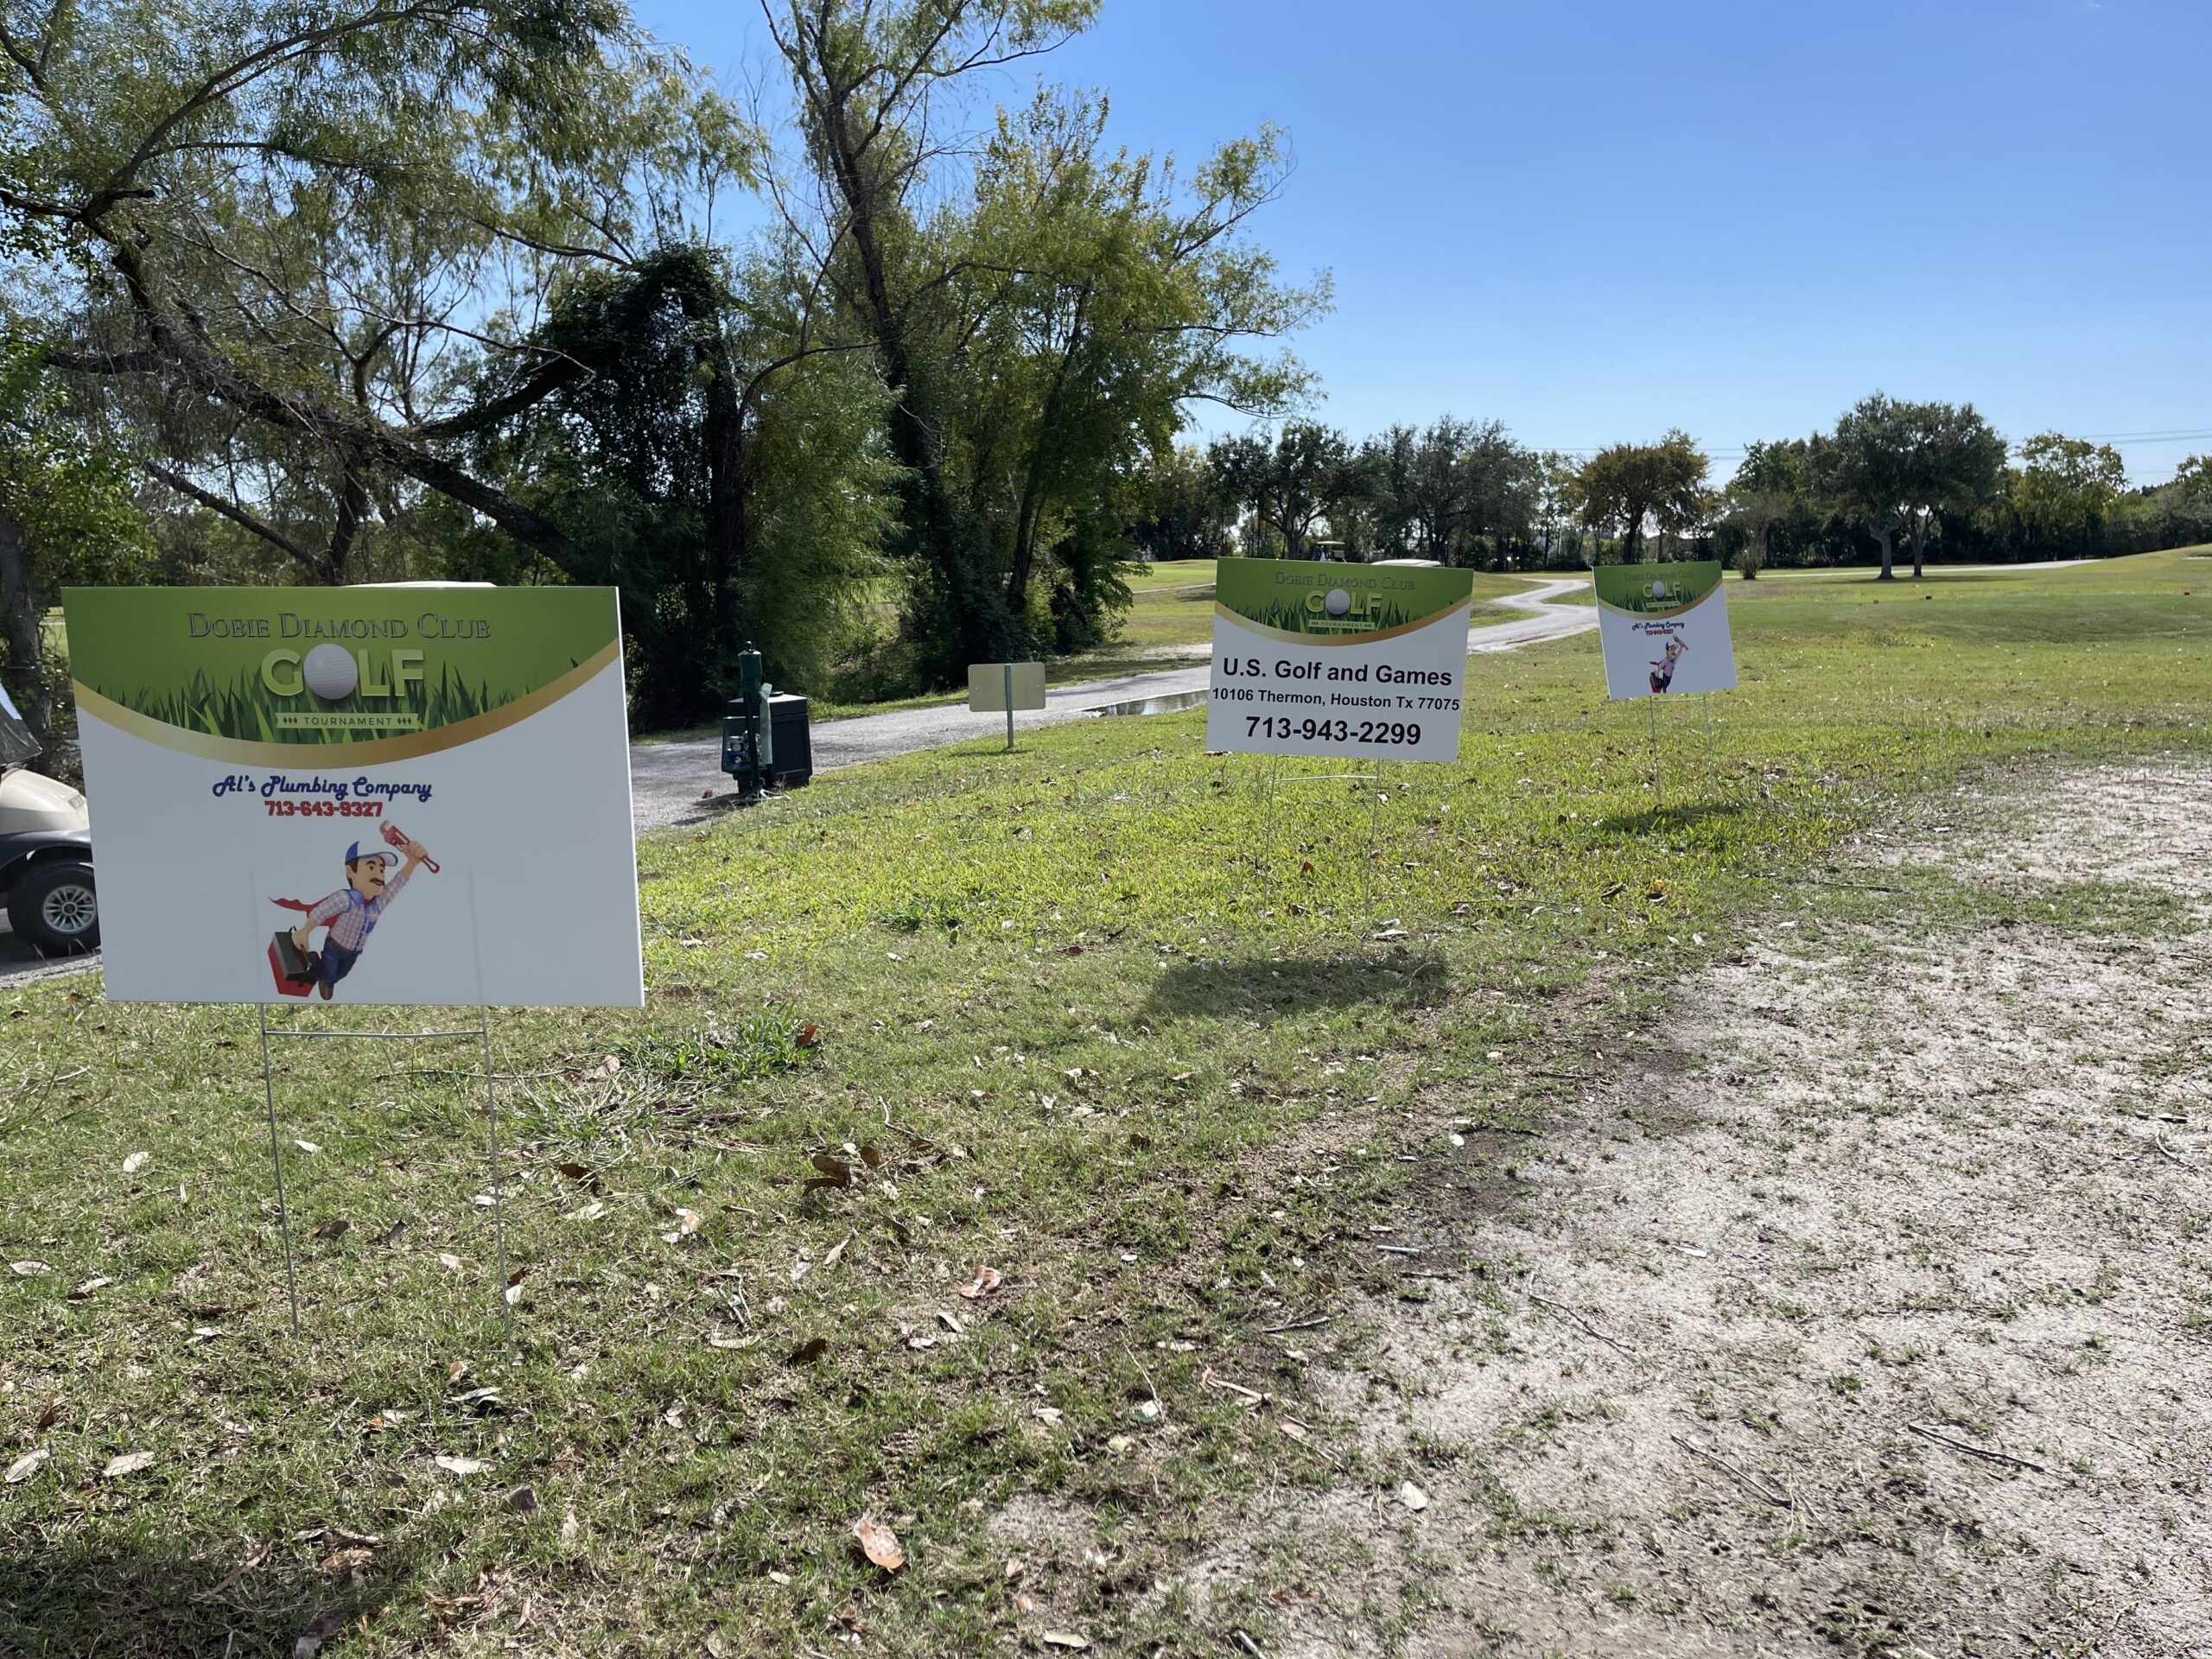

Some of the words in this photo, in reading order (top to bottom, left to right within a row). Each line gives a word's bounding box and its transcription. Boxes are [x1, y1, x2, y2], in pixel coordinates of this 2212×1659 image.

[1306, 588, 1382, 615] GOLF
[1643, 581, 1681, 599] GOLF
[188, 613, 271, 639] DOBIE
[280, 613, 409, 639] DIAMOND
[417, 613, 493, 639] CLUB
[261, 643, 425, 701] GOLF
[1224, 658, 1267, 677] U.S.
[1274, 660, 1322, 680] Golf
[1327, 664, 1368, 683] and
[1376, 664, 1452, 686] Games
[1212, 687, 1254, 702] 10106
[1258, 690, 1326, 706] Thermon,
[1331, 694, 1391, 709] Houston
[1396, 696, 1413, 709] Tx
[1418, 696, 1459, 711] 77075
[303, 715, 393, 728] TOURNAMENT
[1245, 716, 1421, 745] 713-943-2299
[212, 775, 256, 798] Al's
[261, 775, 348, 801] Plumbing
[353, 778, 432, 802] Company
[264, 801, 383, 817] 713-643-9327
